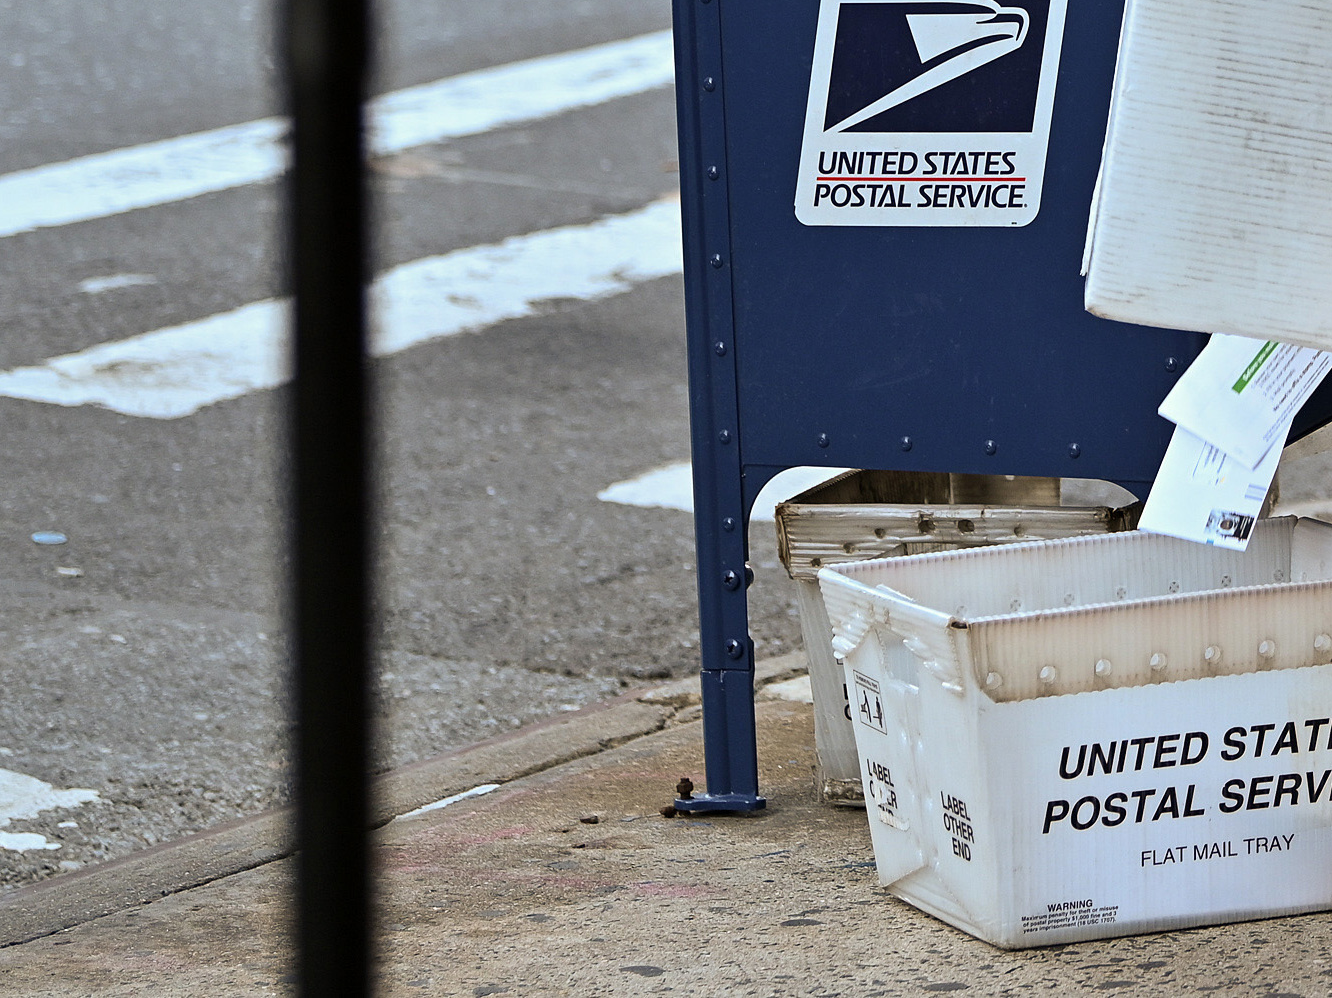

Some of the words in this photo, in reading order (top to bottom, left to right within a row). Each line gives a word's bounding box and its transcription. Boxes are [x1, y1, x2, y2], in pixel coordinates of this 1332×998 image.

[817, 151, 919, 175] UNITED
[922, 151, 1017, 176] STATES
[813, 184, 912, 208] POSTAL
[1058, 731, 1210, 780] UNITED
[867, 759, 895, 788] LABEL
[940, 790, 971, 822] LABEL
[1042, 784, 1206, 835] POSTAL
[943, 812, 975, 844] OTHER
[951, 837, 971, 862] END
[1141, 846, 1188, 868] FLAT
[1193, 841, 1238, 861] MAIL
[1243, 833, 1296, 855] TRAY
[1047, 899, 1093, 913] WARNING
[1048, 911, 1068, 920] penalty
[1030, 919, 1047, 928] postal
[1047, 917, 1071, 926] property
[1039, 922, 1077, 932] imprisonment
